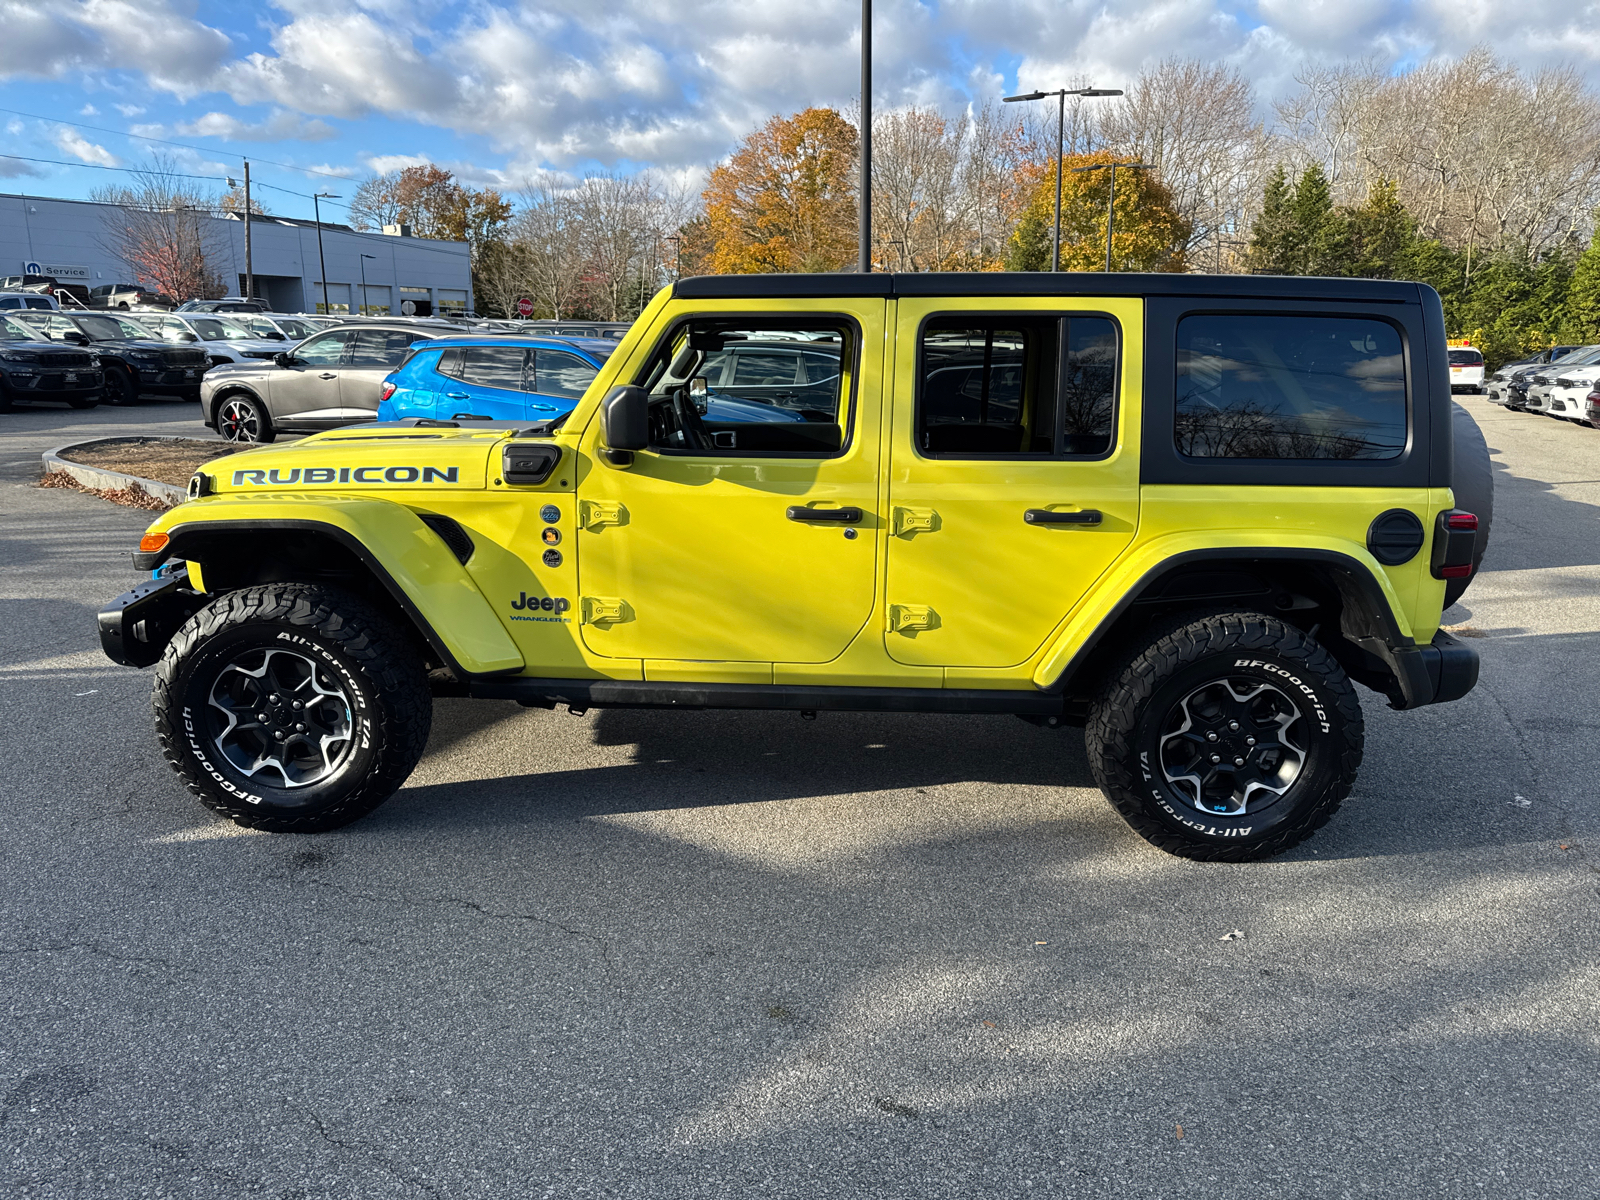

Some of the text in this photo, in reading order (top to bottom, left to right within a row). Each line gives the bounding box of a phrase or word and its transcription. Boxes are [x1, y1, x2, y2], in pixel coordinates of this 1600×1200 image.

[46, 266, 85, 276] Service
[519, 303, 533, 312] STOP
[232, 466, 459, 486] RUBICON
[511, 591, 569, 615] Jeep
[277, 631, 371, 749] All-Terrain T/A
[1234, 659, 1331, 734] BFGoodrich
[182, 706, 263, 805] BFGoodrich
[1140, 751, 1253, 837] All-Terrain T/A
